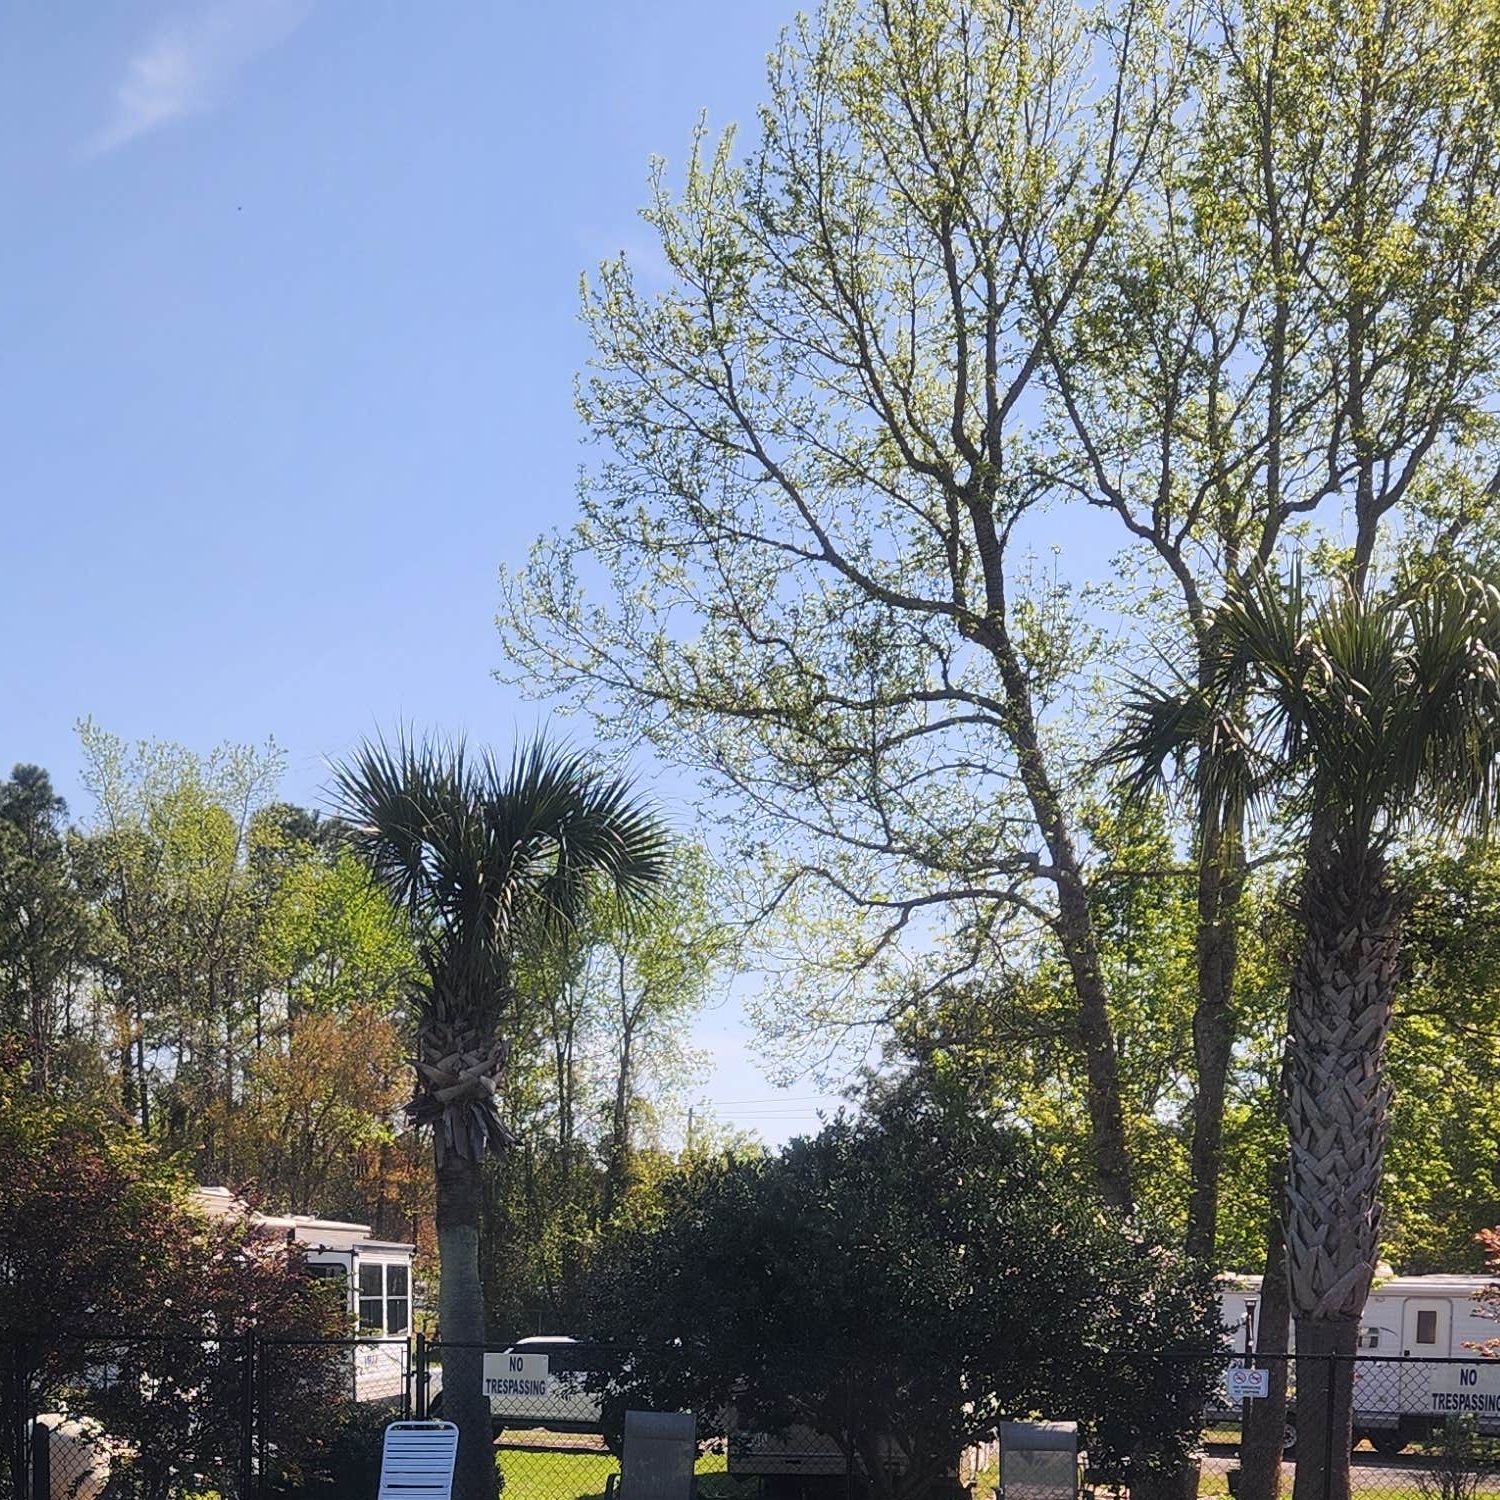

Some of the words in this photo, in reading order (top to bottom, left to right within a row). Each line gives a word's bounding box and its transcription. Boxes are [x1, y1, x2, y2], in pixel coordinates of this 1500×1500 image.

[509, 1356, 523, 1372] NO
[1460, 1368, 1477, 1386] NO
[485, 1378, 546, 1395] TRESPASSING
